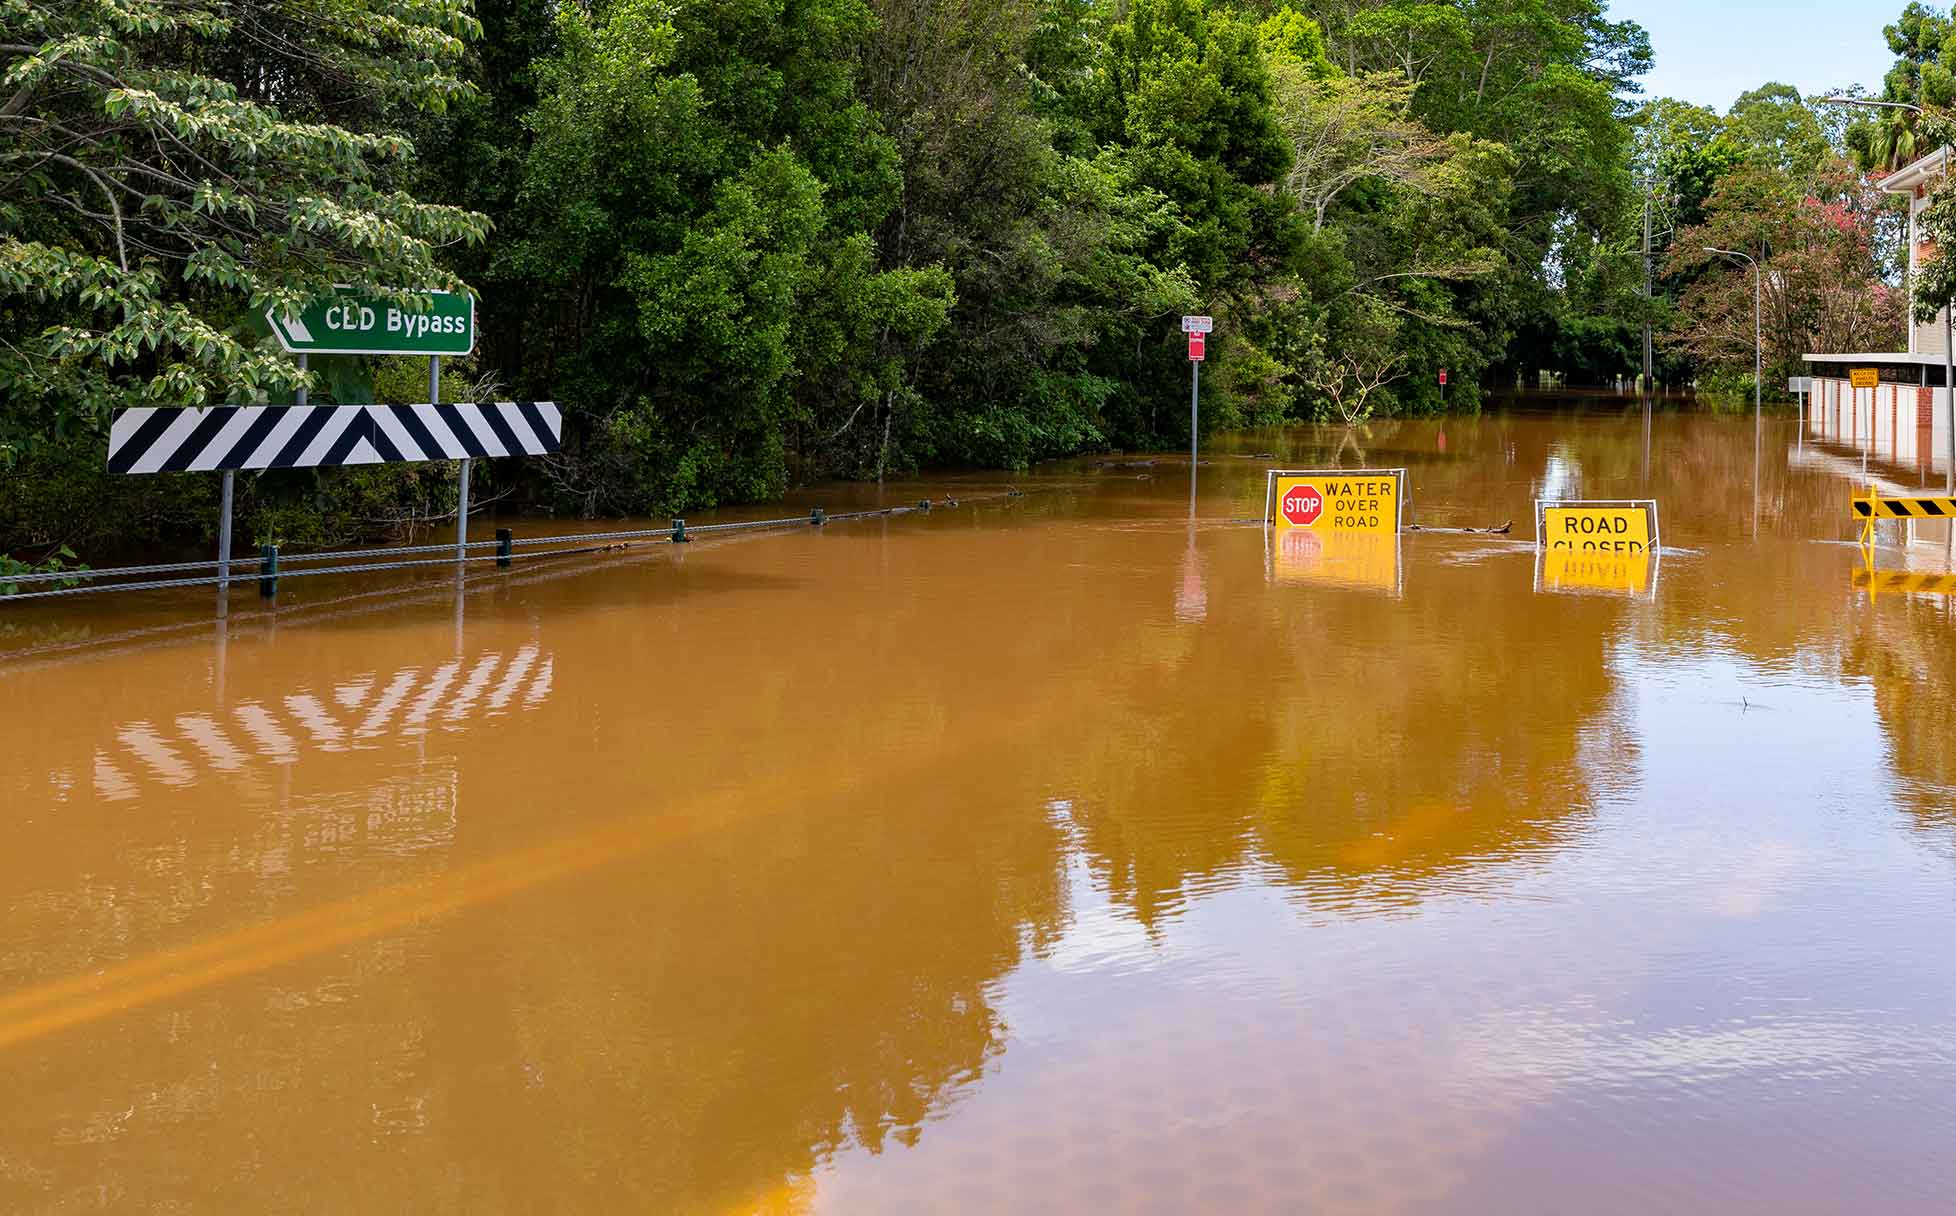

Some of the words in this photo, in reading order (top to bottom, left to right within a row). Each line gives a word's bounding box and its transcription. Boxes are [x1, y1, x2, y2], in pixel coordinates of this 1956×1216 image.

[387, 308, 465, 338] Bypass
[1325, 483, 1391, 496] WATER
[1286, 498, 1319, 513] STOP
[1336, 500, 1379, 511] OVER
[1334, 516, 1379, 528] ROAD
[1565, 517, 1628, 534] ROAD
